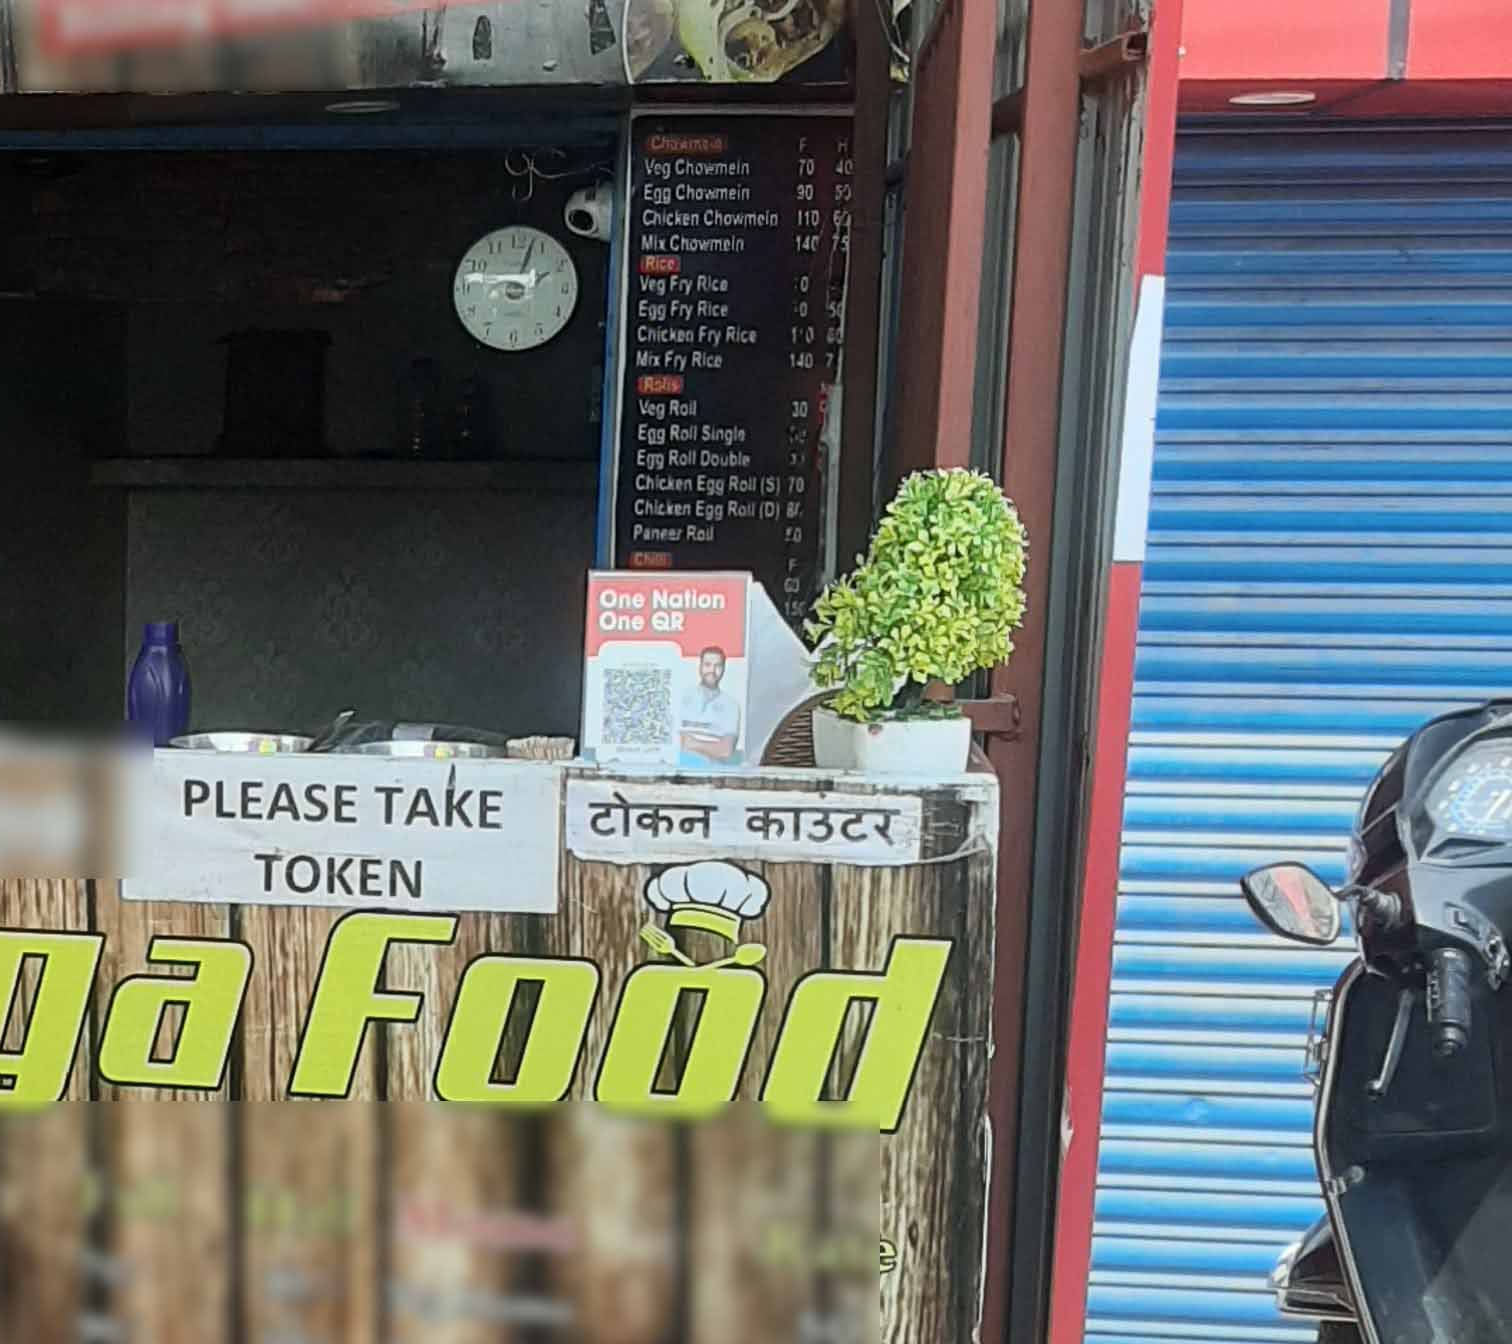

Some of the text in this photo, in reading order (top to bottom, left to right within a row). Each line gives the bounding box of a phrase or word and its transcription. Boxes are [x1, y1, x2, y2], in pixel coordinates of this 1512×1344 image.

[644, 158, 671, 179] Veg
[675, 158, 750, 176] Chowmein
[799, 159, 815, 176] 70
[643, 184, 672, 205] Egg
[675, 184, 751, 201] Chowmein
[642, 209, 699, 226] Chicken
[703, 209, 779, 227] Chowmein
[797, 209, 820, 226] 110
[641, 234, 665, 251] Mix
[669, 234, 745, 252] Chowmein
[644, 255, 676, 271] Rice
[639, 274, 665, 296] Veg
[669, 274, 693, 296] Fry
[696, 274, 729, 293] Rice
[638, 300, 666, 320] Egg
[670, 300, 694, 320] Fry
[697, 300, 729, 318] Rice
[637, 325, 694, 343] Chicken
[698, 325, 722, 346] Fry
[726, 325, 758, 344] Rice
[636, 350, 660, 367] Mix
[664, 350, 688, 371] Fry
[691, 350, 723, 369] Rice
[639, 399, 808, 420] Veg Roll 30
[637, 423, 746, 446] Egg Roll Single
[637, 448, 751, 470] Egg Roll Double
[635, 474, 693, 492] Chicken
[696, 474, 725, 496] Egg
[729, 474, 757, 493] Roll
[759, 475, 781, 497] (S)
[634, 499, 691, 517] Chicken
[695, 500, 724, 521] Egg
[727, 500, 755, 518] Roll
[759, 500, 781, 521] (D)
[632, 523, 683, 542] Paneer
[686, 524, 715, 542] Roll
[598, 588, 726, 610] One Nation
[598, 610, 687, 632] One QR
[184, 778, 505, 830] PLEASE TAKE
[587, 791, 901, 845] टोकन काउंटर
[254, 852, 423, 899] TOKEN
[290, 908, 955, 1136] Food
